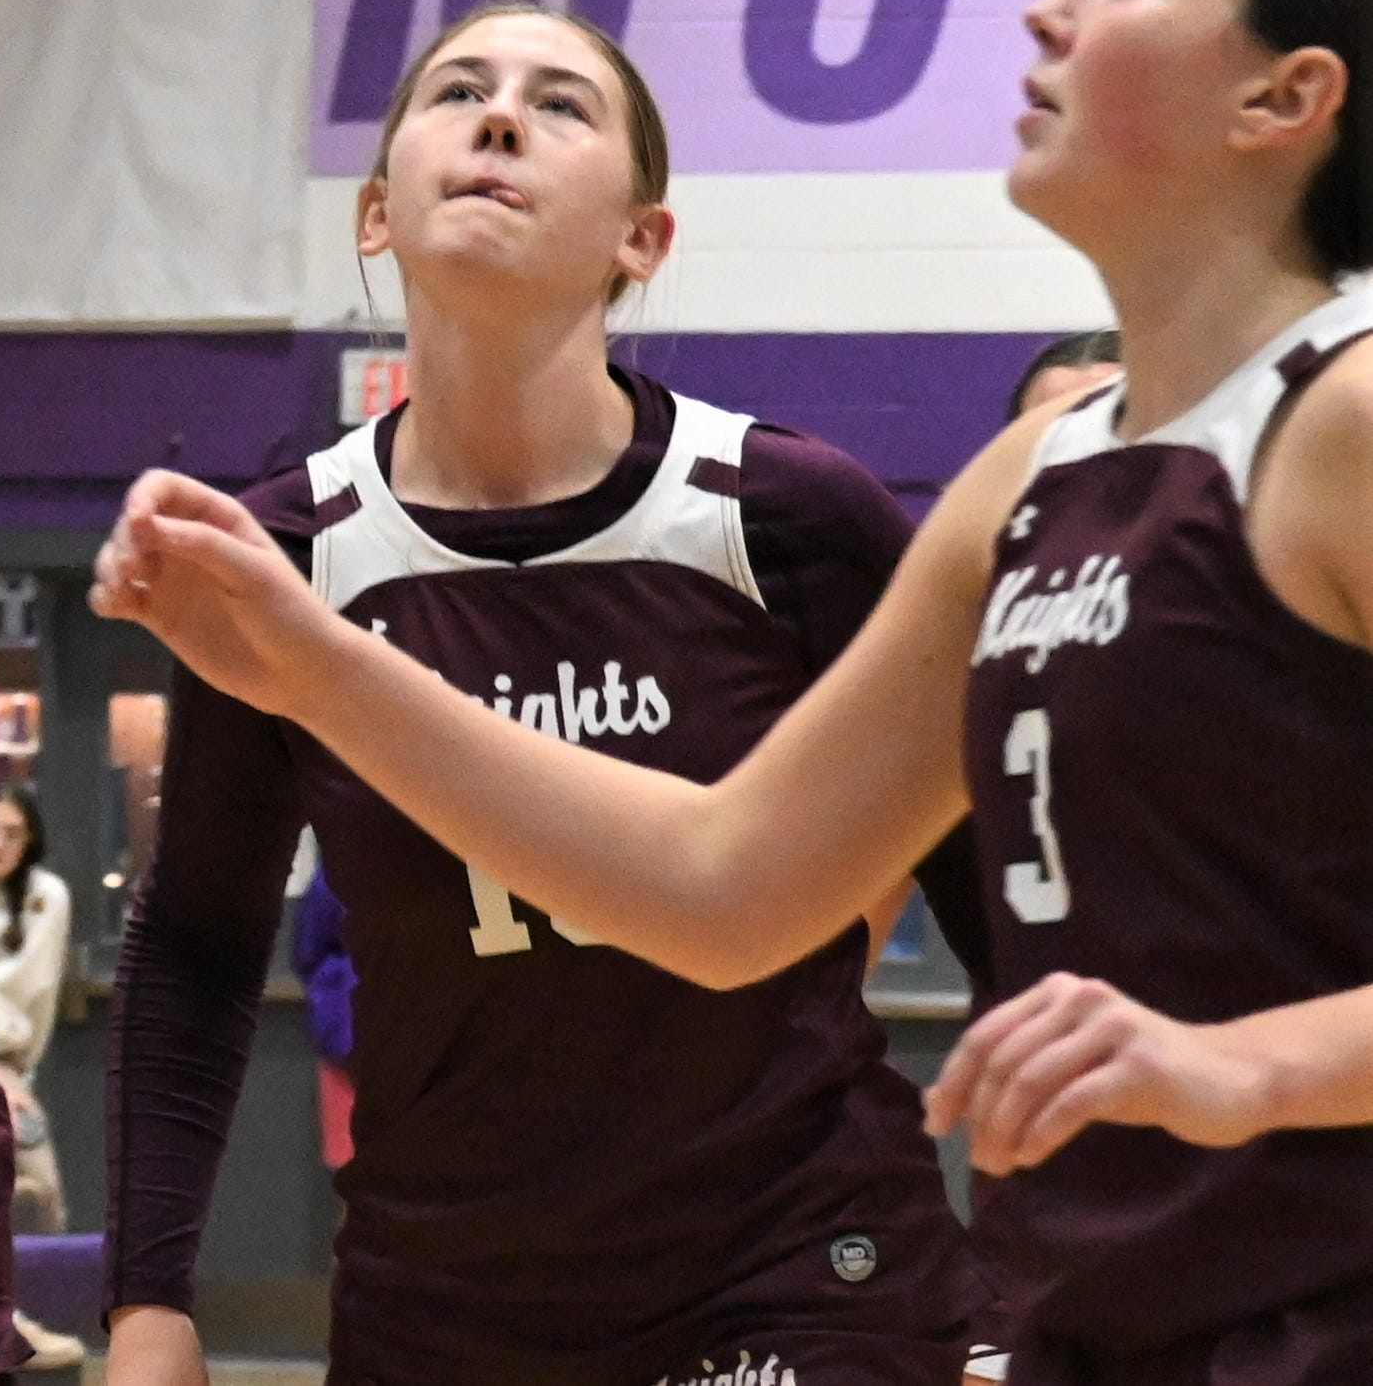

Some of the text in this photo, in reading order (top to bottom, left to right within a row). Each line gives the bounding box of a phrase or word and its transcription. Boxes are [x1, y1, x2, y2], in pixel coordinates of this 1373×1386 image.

[972, 554, 1131, 674] Knights
[466, 659, 671, 744] ights
[1003, 708, 1071, 924] 3
